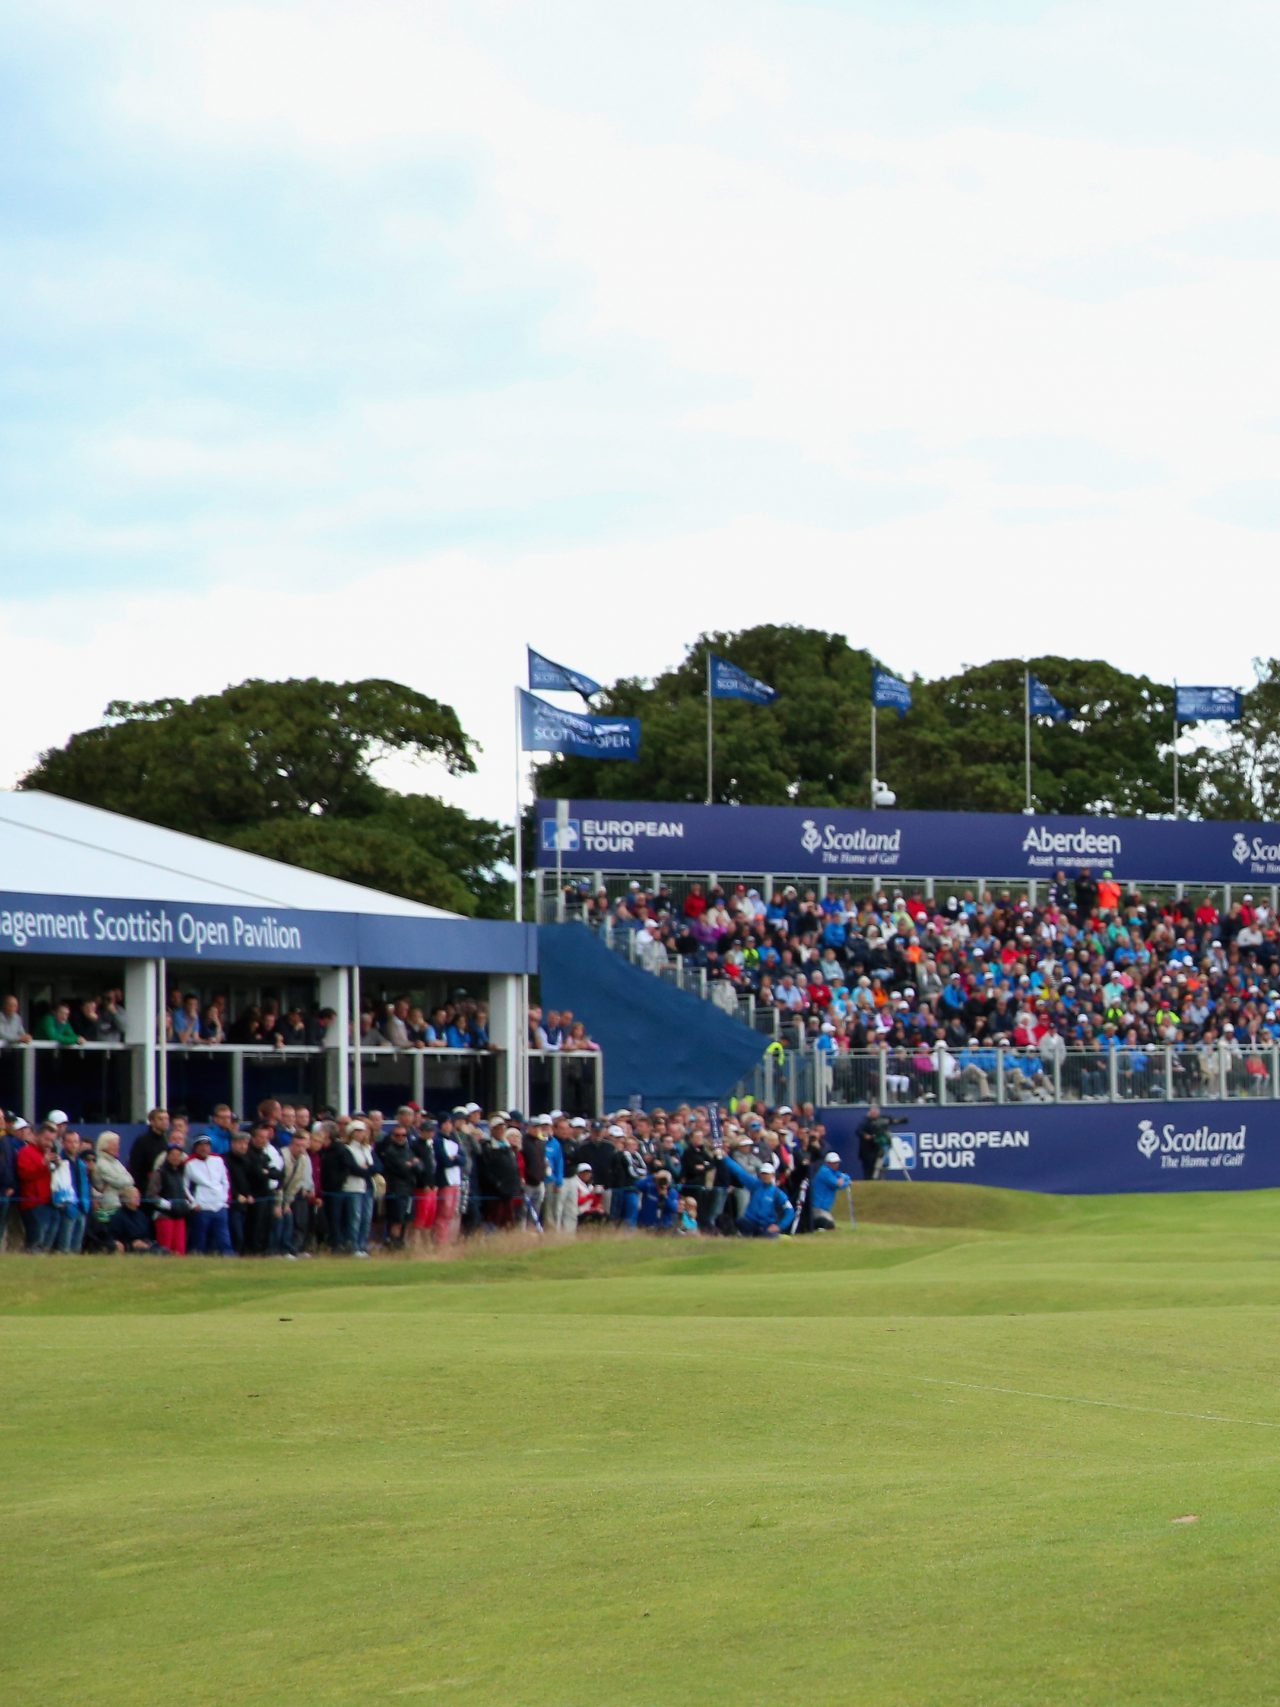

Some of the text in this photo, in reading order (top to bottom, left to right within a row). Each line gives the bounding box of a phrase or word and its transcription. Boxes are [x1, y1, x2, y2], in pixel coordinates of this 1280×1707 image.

[582, 820, 684, 837] EUROPEAN
[583, 836, 635, 852] TOUR
[822, 824, 901, 851] Scotland
[1022, 826, 1121, 854] Aberdeen
[822, 851, 899, 865] The Home of Golf
[1028, 855, 1115, 869] Asset management
[1250, 862, 1265, 873] The
[0, 907, 302, 953] agement Scottish Open Pavilion
[919, 1130, 1029, 1150] EUROPEAN
[1160, 1123, 1246, 1152] Scotland
[920, 1150, 976, 1168] TOUR
[1161, 1153, 1245, 1168] The Home of Golf
